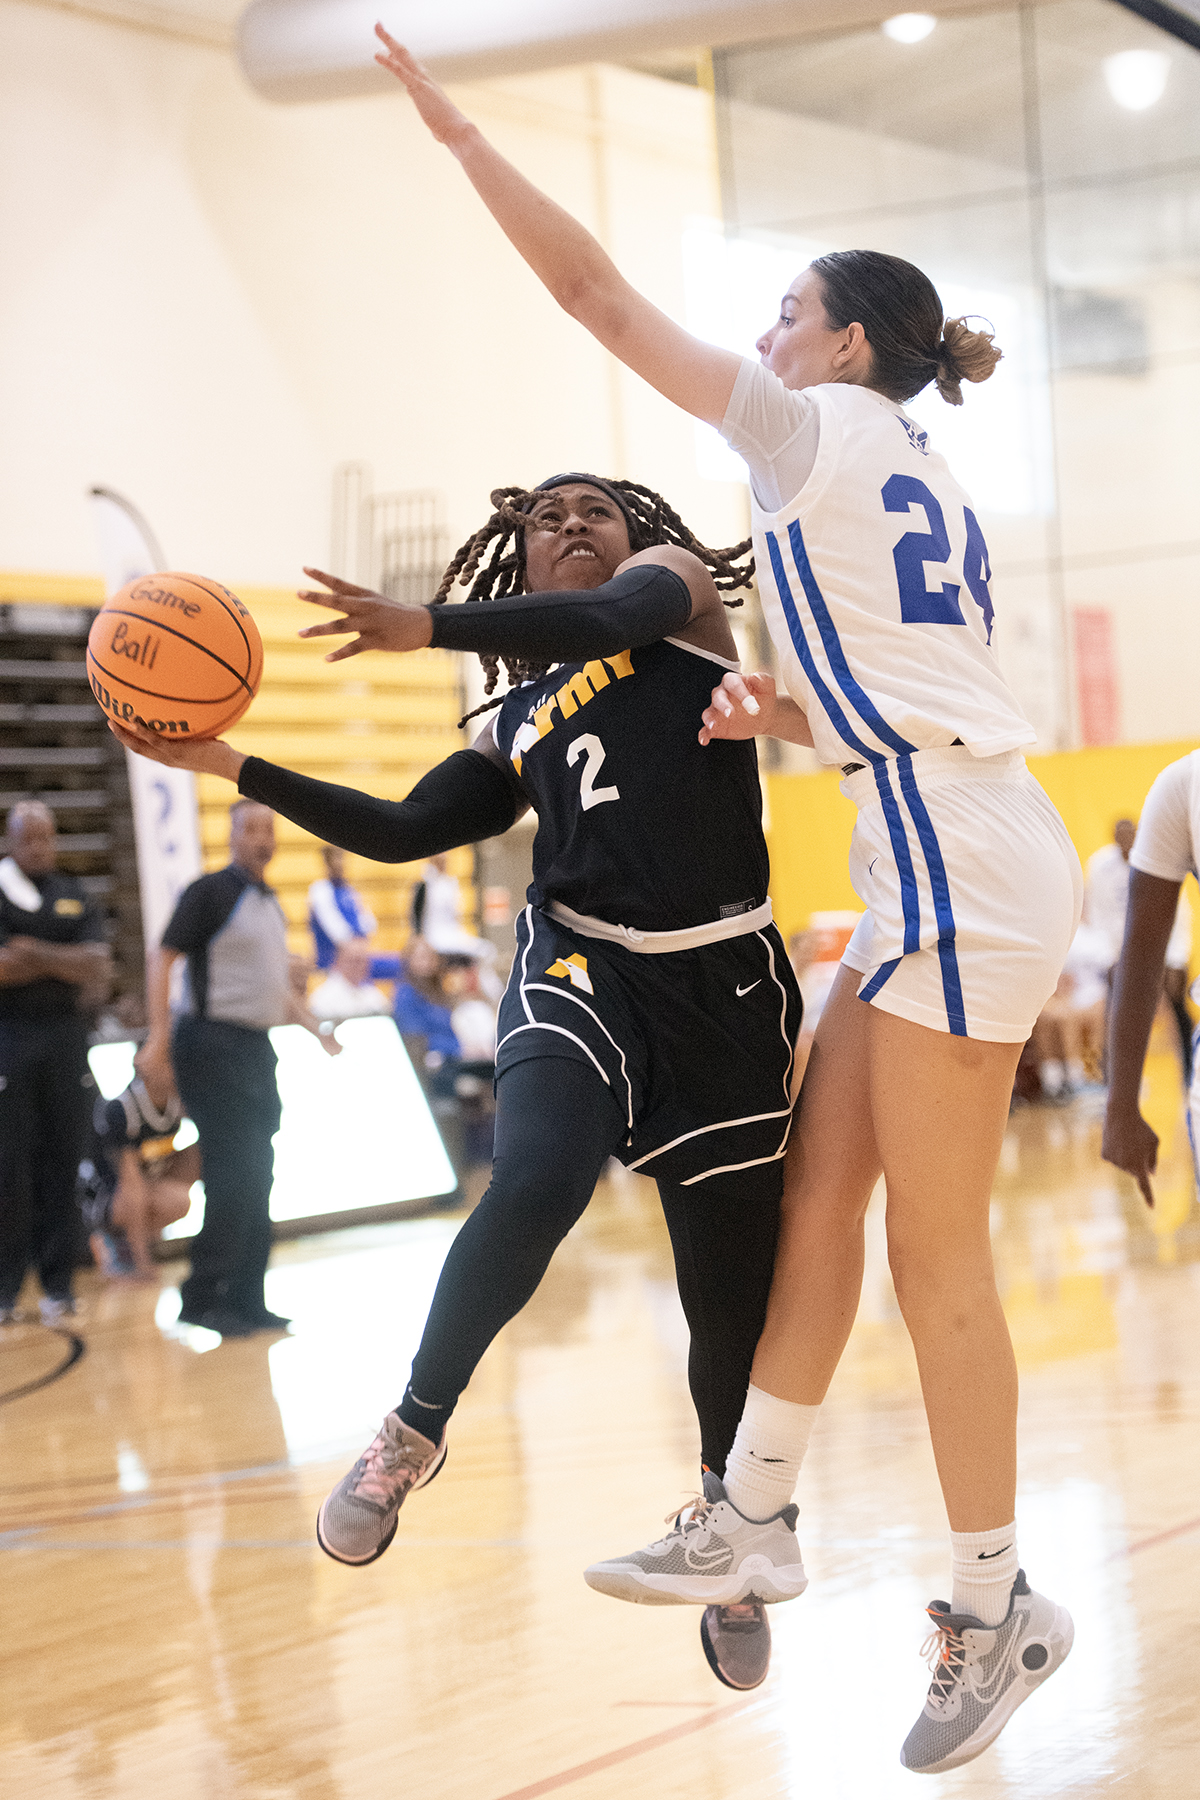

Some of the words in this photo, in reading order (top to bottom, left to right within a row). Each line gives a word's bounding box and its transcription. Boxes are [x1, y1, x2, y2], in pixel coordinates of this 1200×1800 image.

[880, 473, 996, 647] 24
[130, 580, 202, 619] Game
[110, 621, 160, 670] Ball
[91, 672, 190, 733] Wilson
[566, 732, 620, 811] 2
